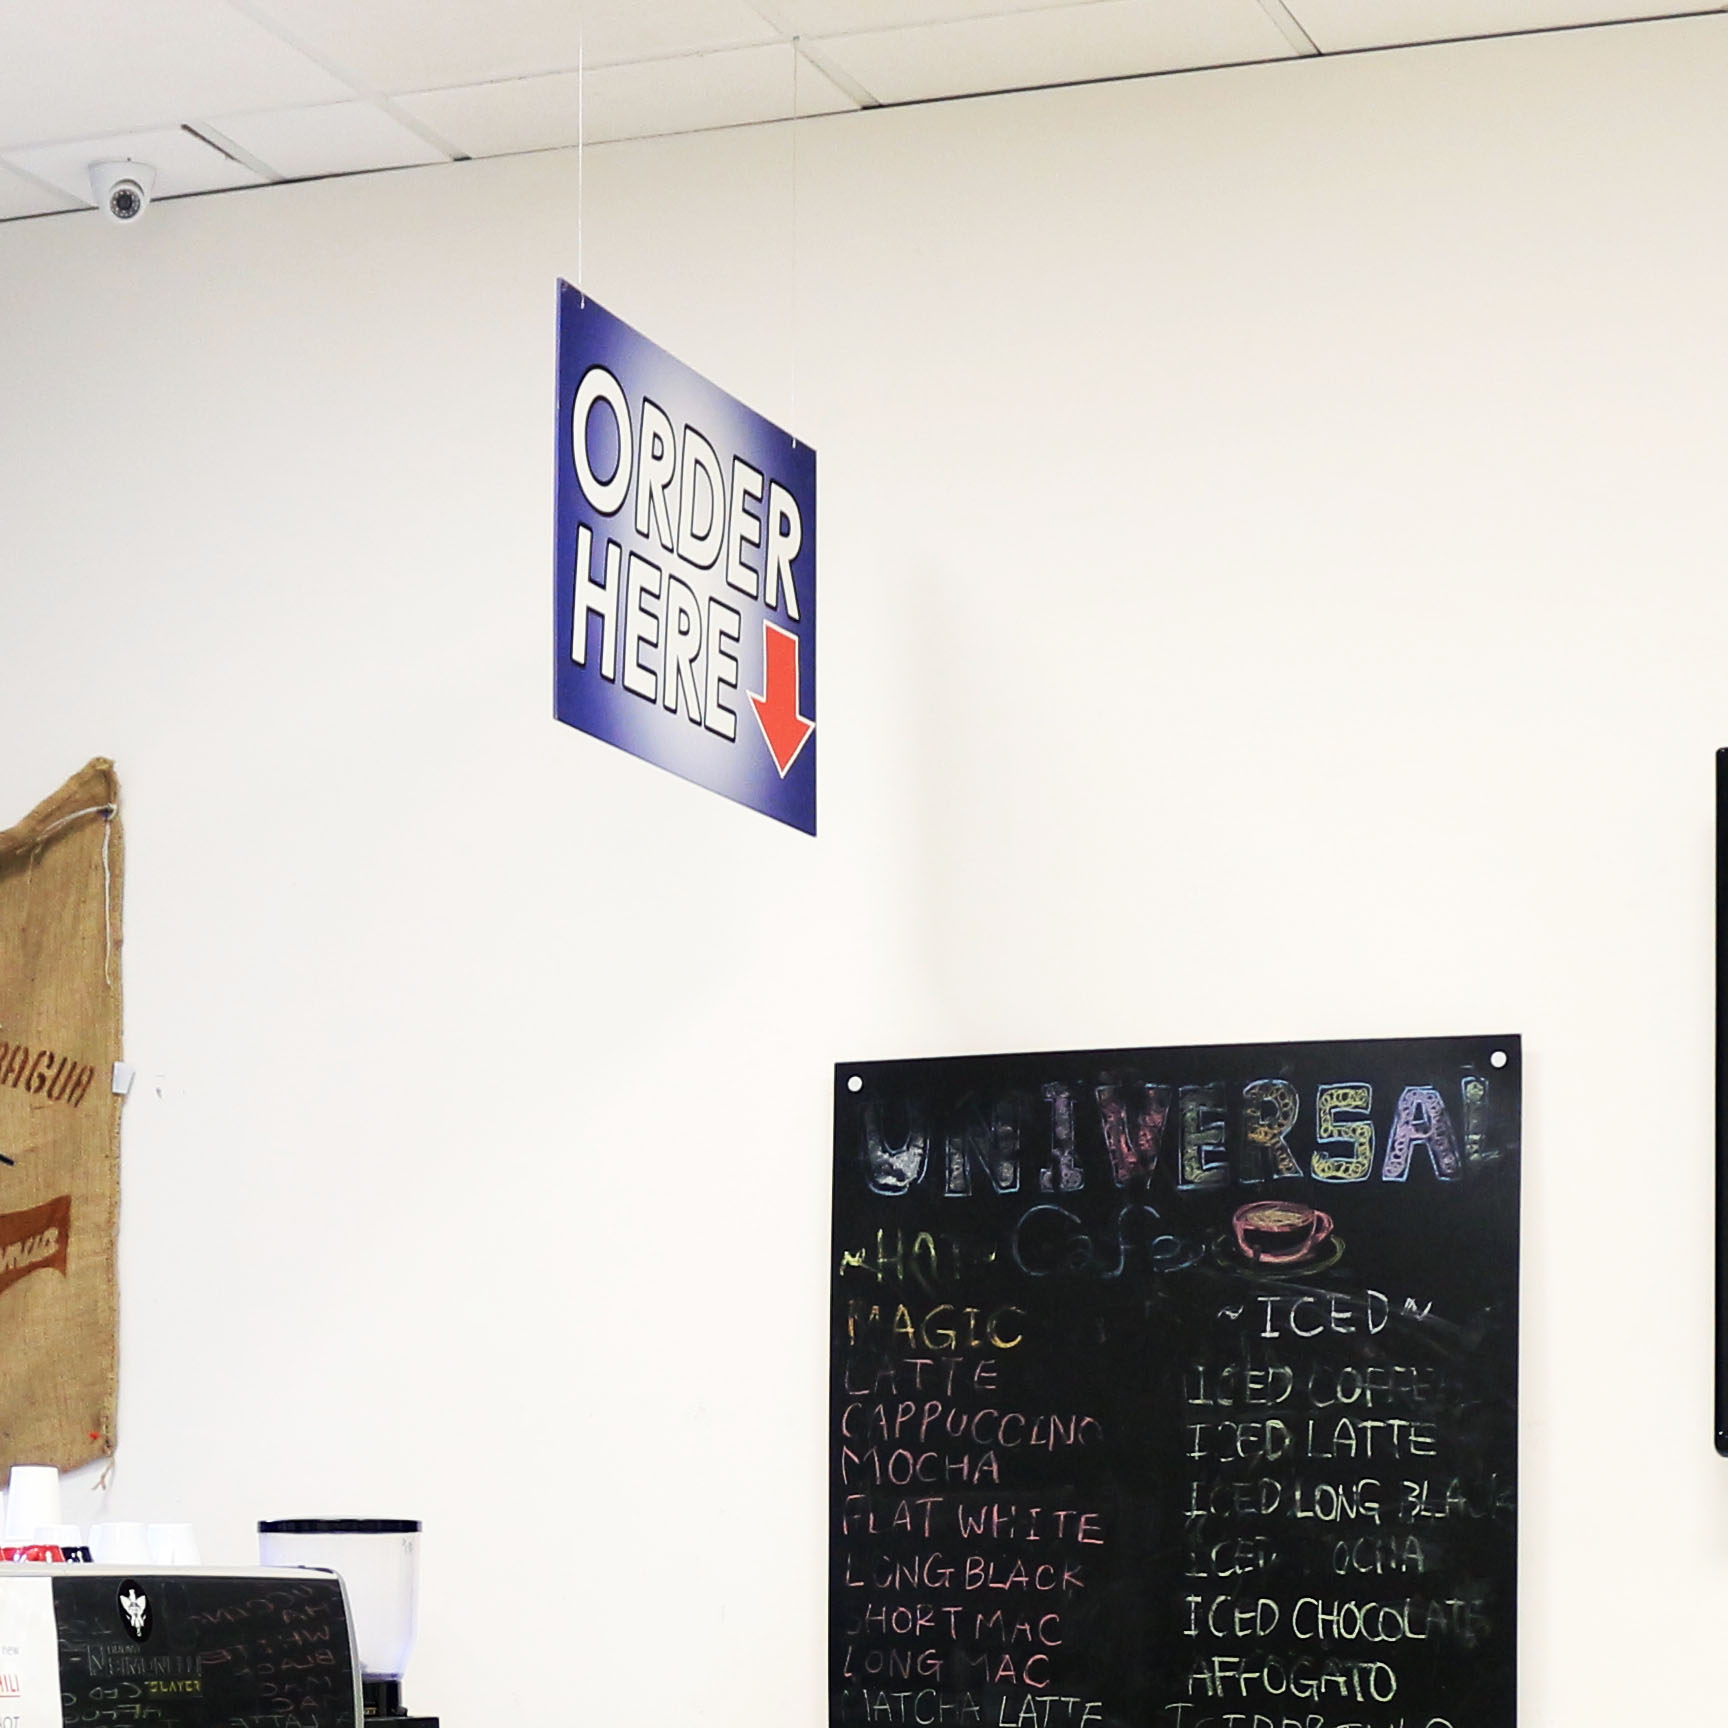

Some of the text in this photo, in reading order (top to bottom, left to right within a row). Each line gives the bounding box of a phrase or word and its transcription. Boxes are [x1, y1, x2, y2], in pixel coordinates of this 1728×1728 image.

[571, 364, 803, 621] ORDER
[571, 523, 741, 743] HERE
[1256, 1290, 1390, 1338] ICED
[843, 1356, 998, 1397] LATTE
[1306, 1417, 1438, 1460] LATTE
[841, 1445, 1001, 1486] MOCHA
[842, 1494, 1104, 1544] FLAT WHITE
[1294, 1478, 1381, 1525] LONG
[844, 1552, 1086, 1592] LONG BLACK
[974, 1609, 1062, 1646] MAC
[1183, 1594, 1280, 1638] ICED
[843, 1645, 944, 1683] LONG
[1187, 1654, 1397, 1703] AFFOGATO
